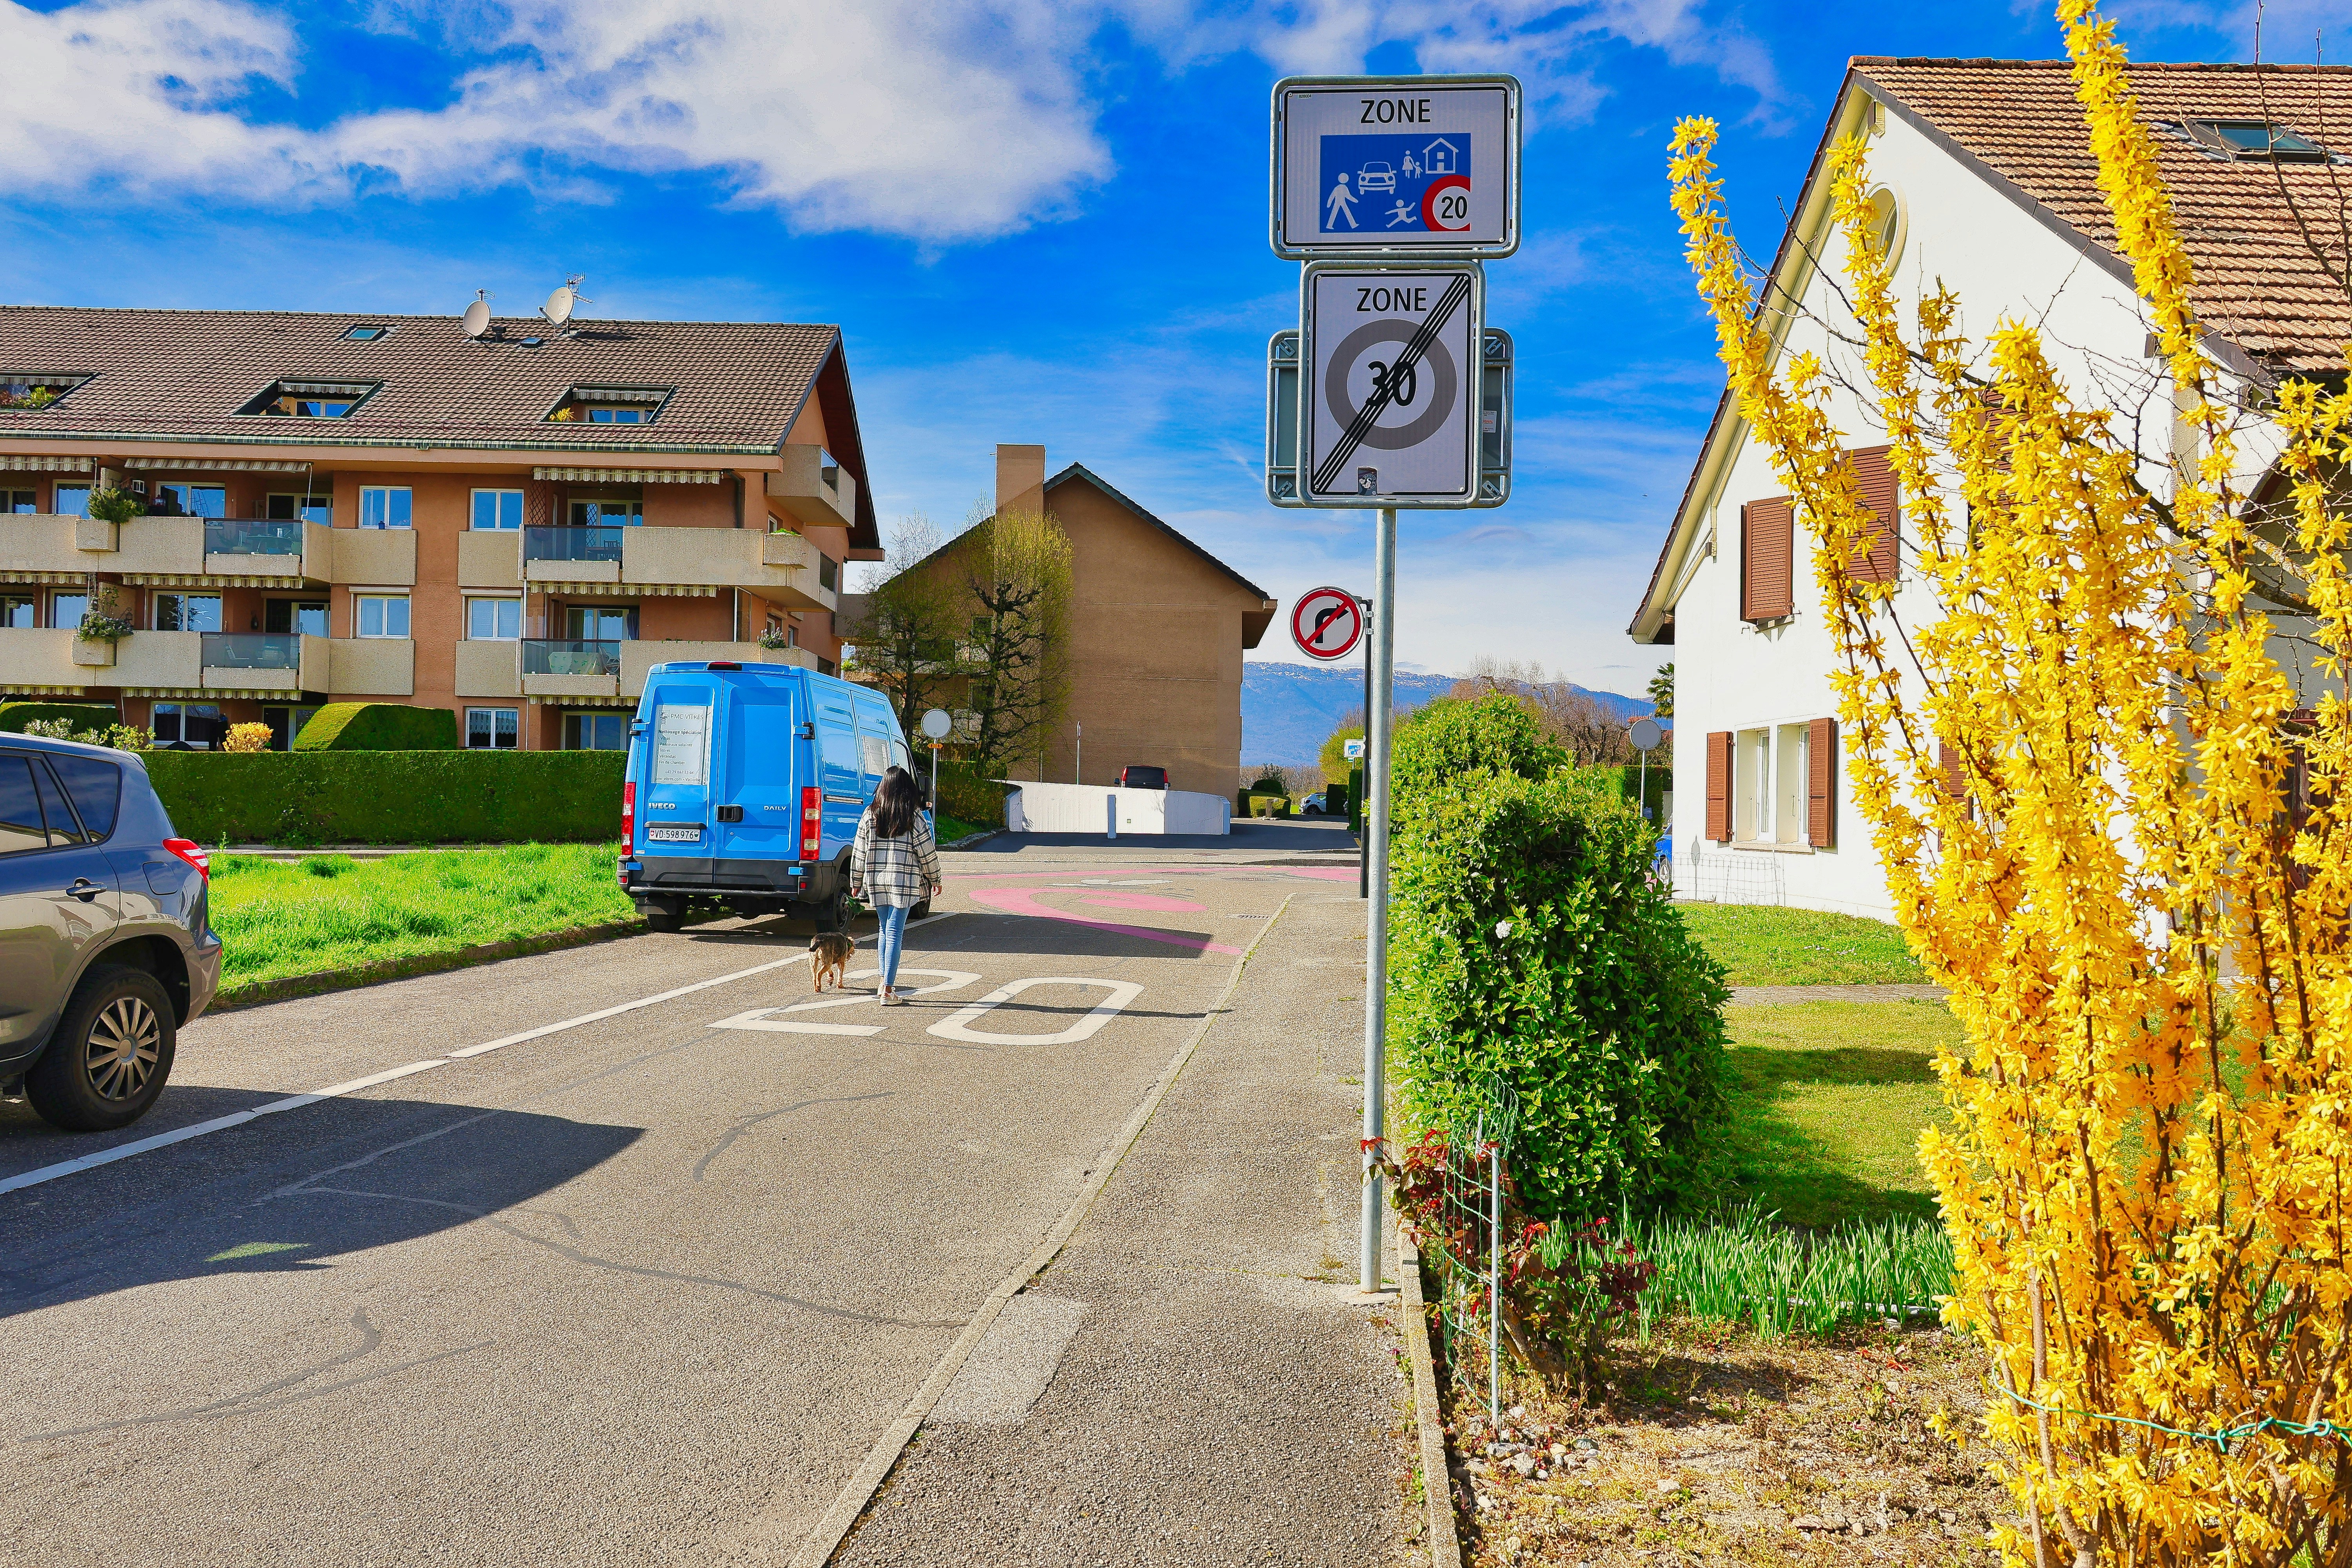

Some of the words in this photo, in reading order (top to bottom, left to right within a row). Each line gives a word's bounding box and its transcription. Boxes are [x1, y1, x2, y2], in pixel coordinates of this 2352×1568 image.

[1360, 99, 1431, 123] ZONE
[1441, 196, 1468, 219] 20
[1357, 288, 1427, 312] ZONE
[1365, 360, 1417, 407] 30
[706, 968, 1145, 1046] 20
